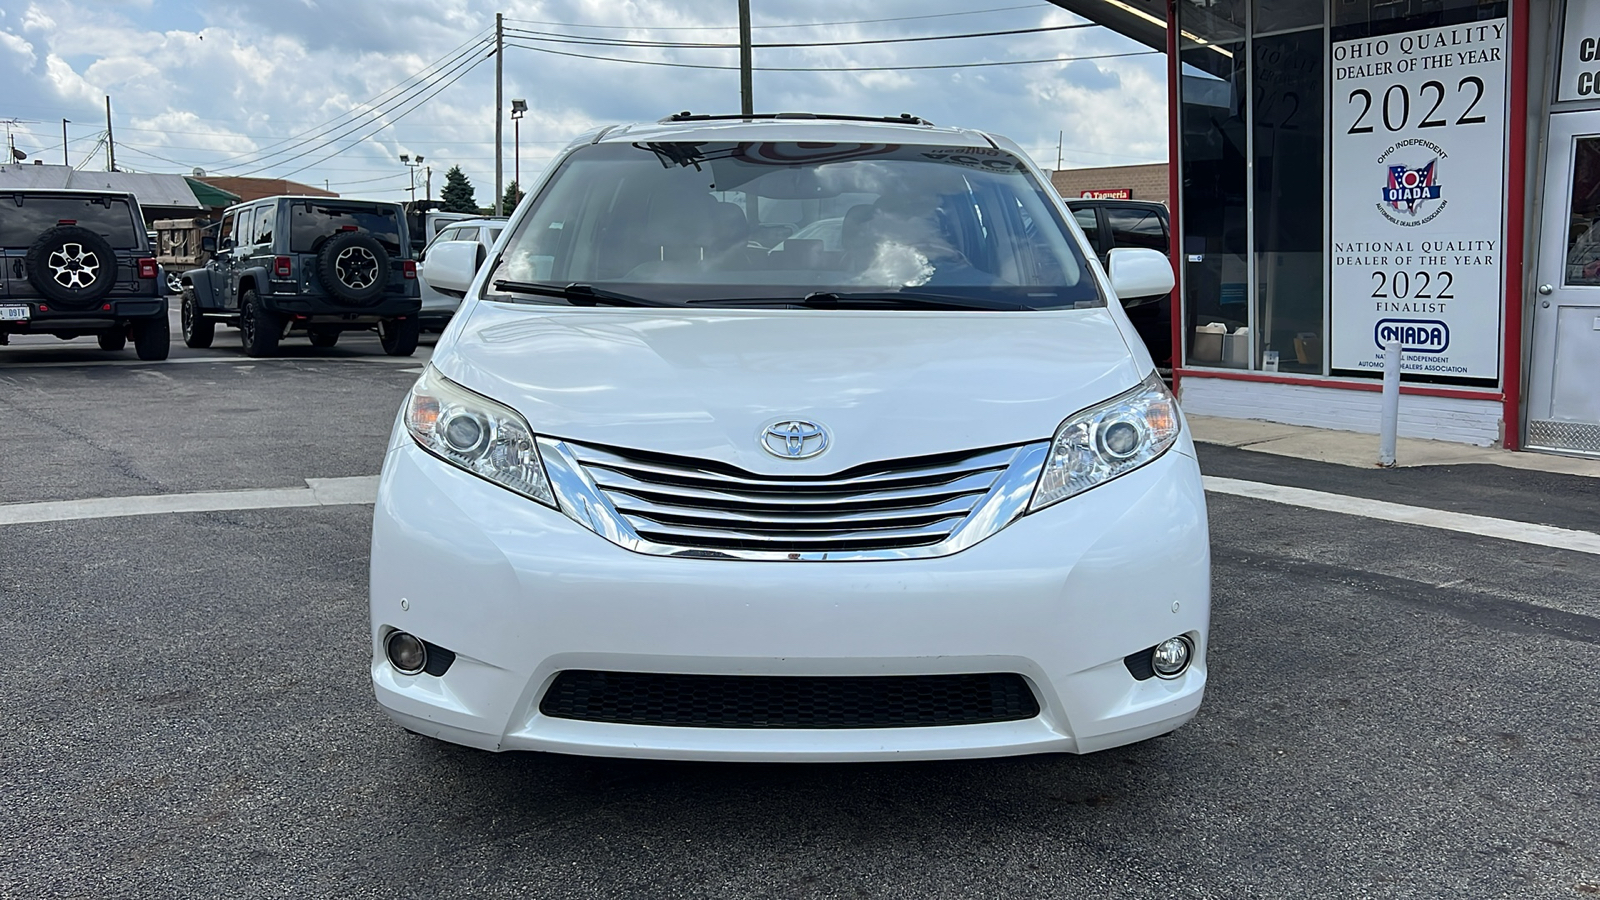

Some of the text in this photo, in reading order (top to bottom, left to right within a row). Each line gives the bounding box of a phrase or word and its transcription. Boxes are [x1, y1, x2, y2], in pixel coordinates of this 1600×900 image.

[1334, 40, 1389, 61] OHIO
[1400, 23, 1505, 54] QUALITY
[1336, 62, 1393, 80] DEALER
[1397, 58, 1417, 73] OF
[1421, 54, 1453, 70] THE
[1457, 47, 1501, 65] YEAR
[1347, 75, 1486, 135] 2022
[1377, 139, 1448, 164] OHIO INDEPENDENT
[1389, 187, 1431, 200] OIADA
[1376, 203, 1399, 226] AUTOMOBILE
[1421, 199, 1448, 224] ASSOCIATION
[1335, 240, 1496, 254] NATIONAL QUALITY
[1336, 255, 1493, 266] DEALER OF THE YEAR
[1371, 271, 1454, 299] 2022
[1376, 302, 1446, 313] FINALIST
[1381, 326, 1442, 345] NIADA
[1407, 355, 1449, 363] INDEPENDENT
[1424, 364, 1468, 373] ASSOCIATION
